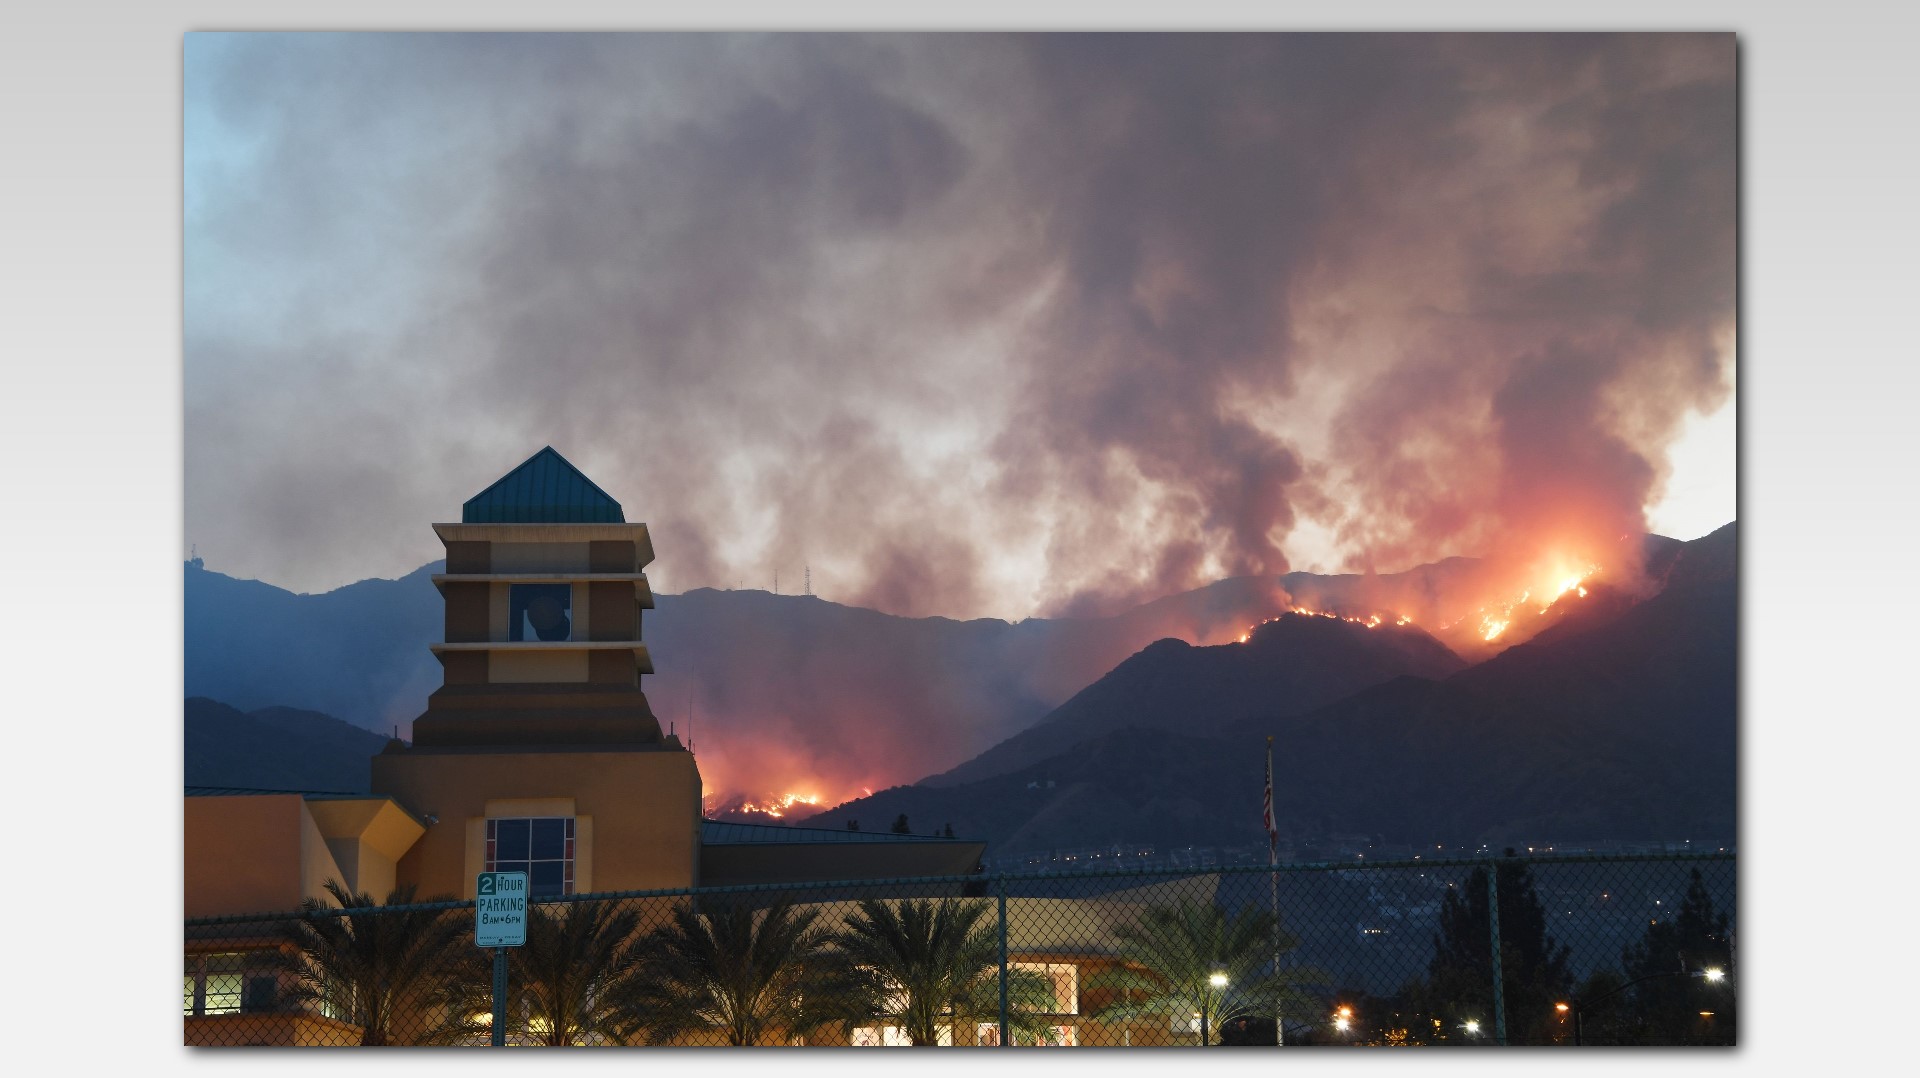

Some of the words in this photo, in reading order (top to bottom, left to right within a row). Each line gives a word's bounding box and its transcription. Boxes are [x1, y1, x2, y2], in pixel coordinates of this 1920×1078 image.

[482, 877, 493, 893] 2
[498, 879, 523, 891] HOUR
[479, 897, 524, 912] PARKING
